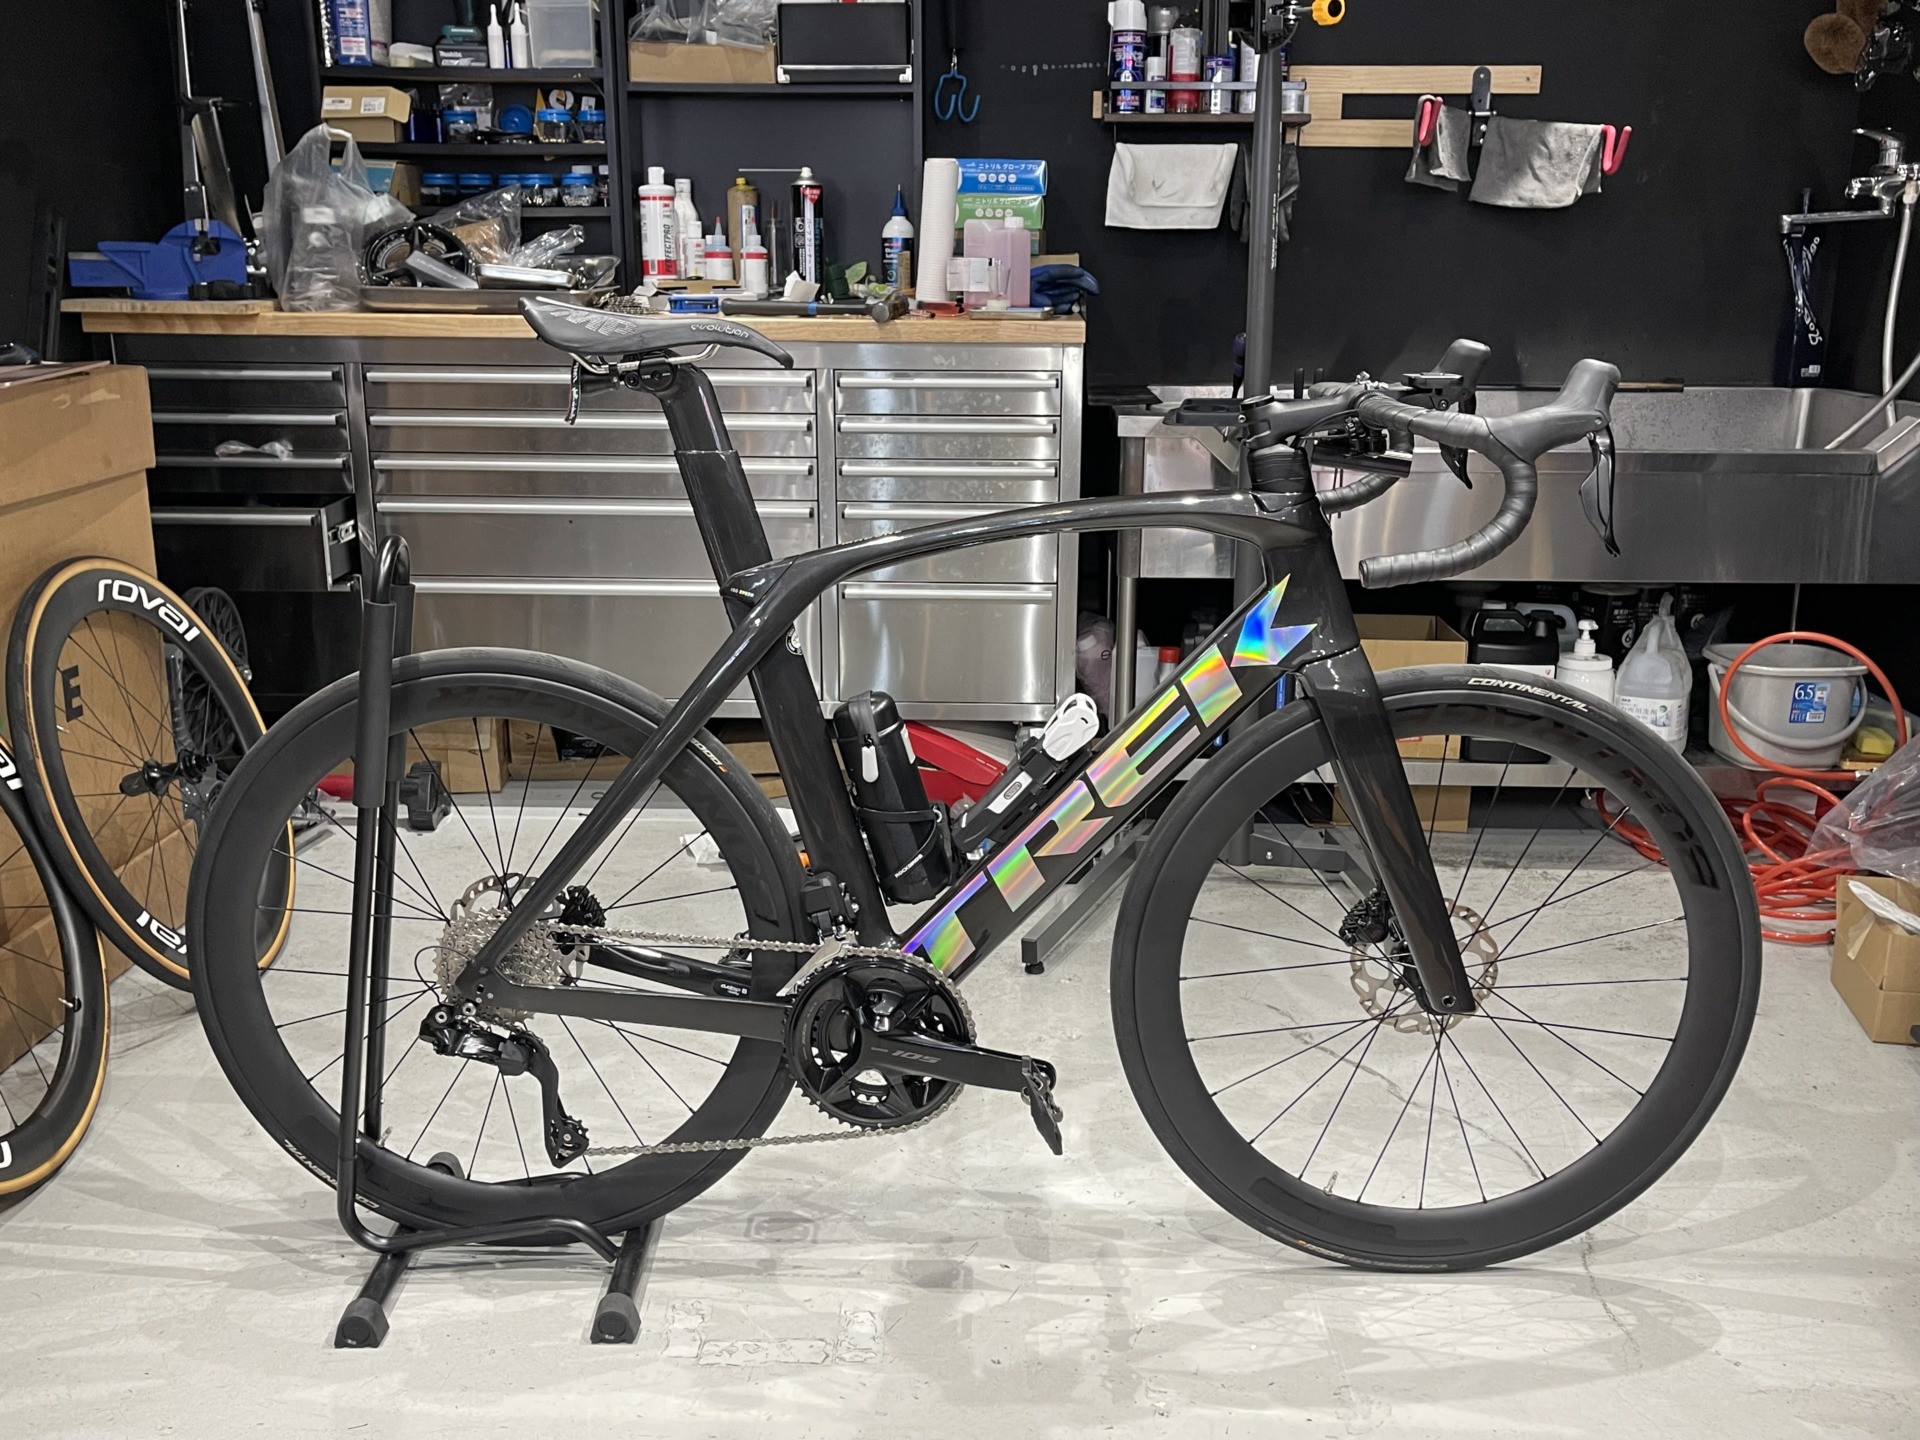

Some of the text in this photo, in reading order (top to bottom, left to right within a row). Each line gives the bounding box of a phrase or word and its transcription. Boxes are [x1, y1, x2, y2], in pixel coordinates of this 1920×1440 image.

[663, 223, 672, 273] PERFECTPRO
[690, 323, 749, 338] evolution
[98, 579, 201, 642] roval
[1467, 677, 1589, 713] CONTINENTAL
[892, 1049, 942, 1064] 105
